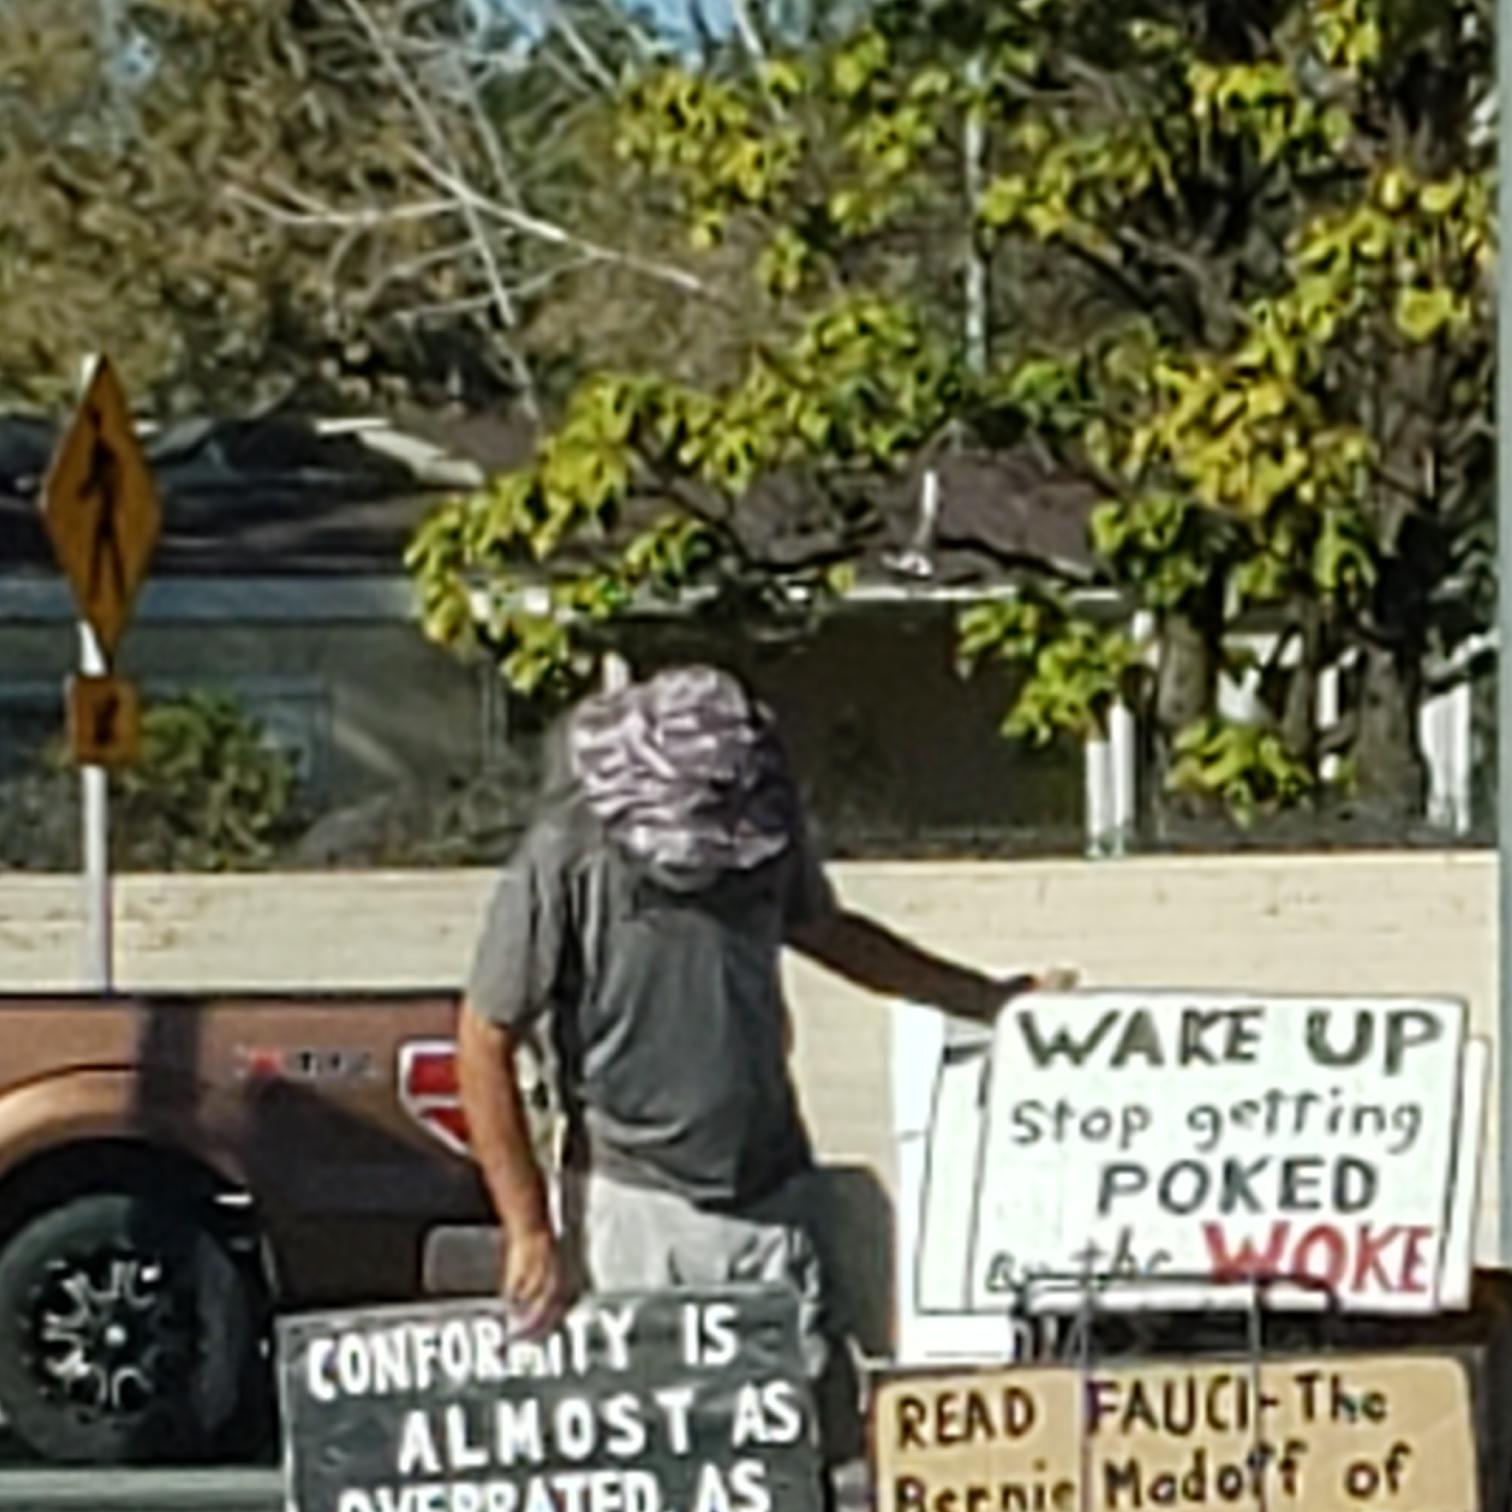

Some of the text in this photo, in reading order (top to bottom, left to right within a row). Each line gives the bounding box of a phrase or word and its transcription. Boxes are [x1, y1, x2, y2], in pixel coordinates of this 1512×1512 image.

[1017, 1006, 1443, 1077] WAKE UP
[1011, 1087, 1423, 1155] Stop getting
[1098, 1154, 1378, 1217] POKED
[1201, 1221, 1434, 1294] WOKE
[683, 1303, 740, 1366] IS
[399, 1381, 800, 1475] ALMOST AS
[897, 1387, 1037, 1450] READ
[1104, 1440, 1307, 1510] Madoff
[1345, 1440, 1411, 1498] of
